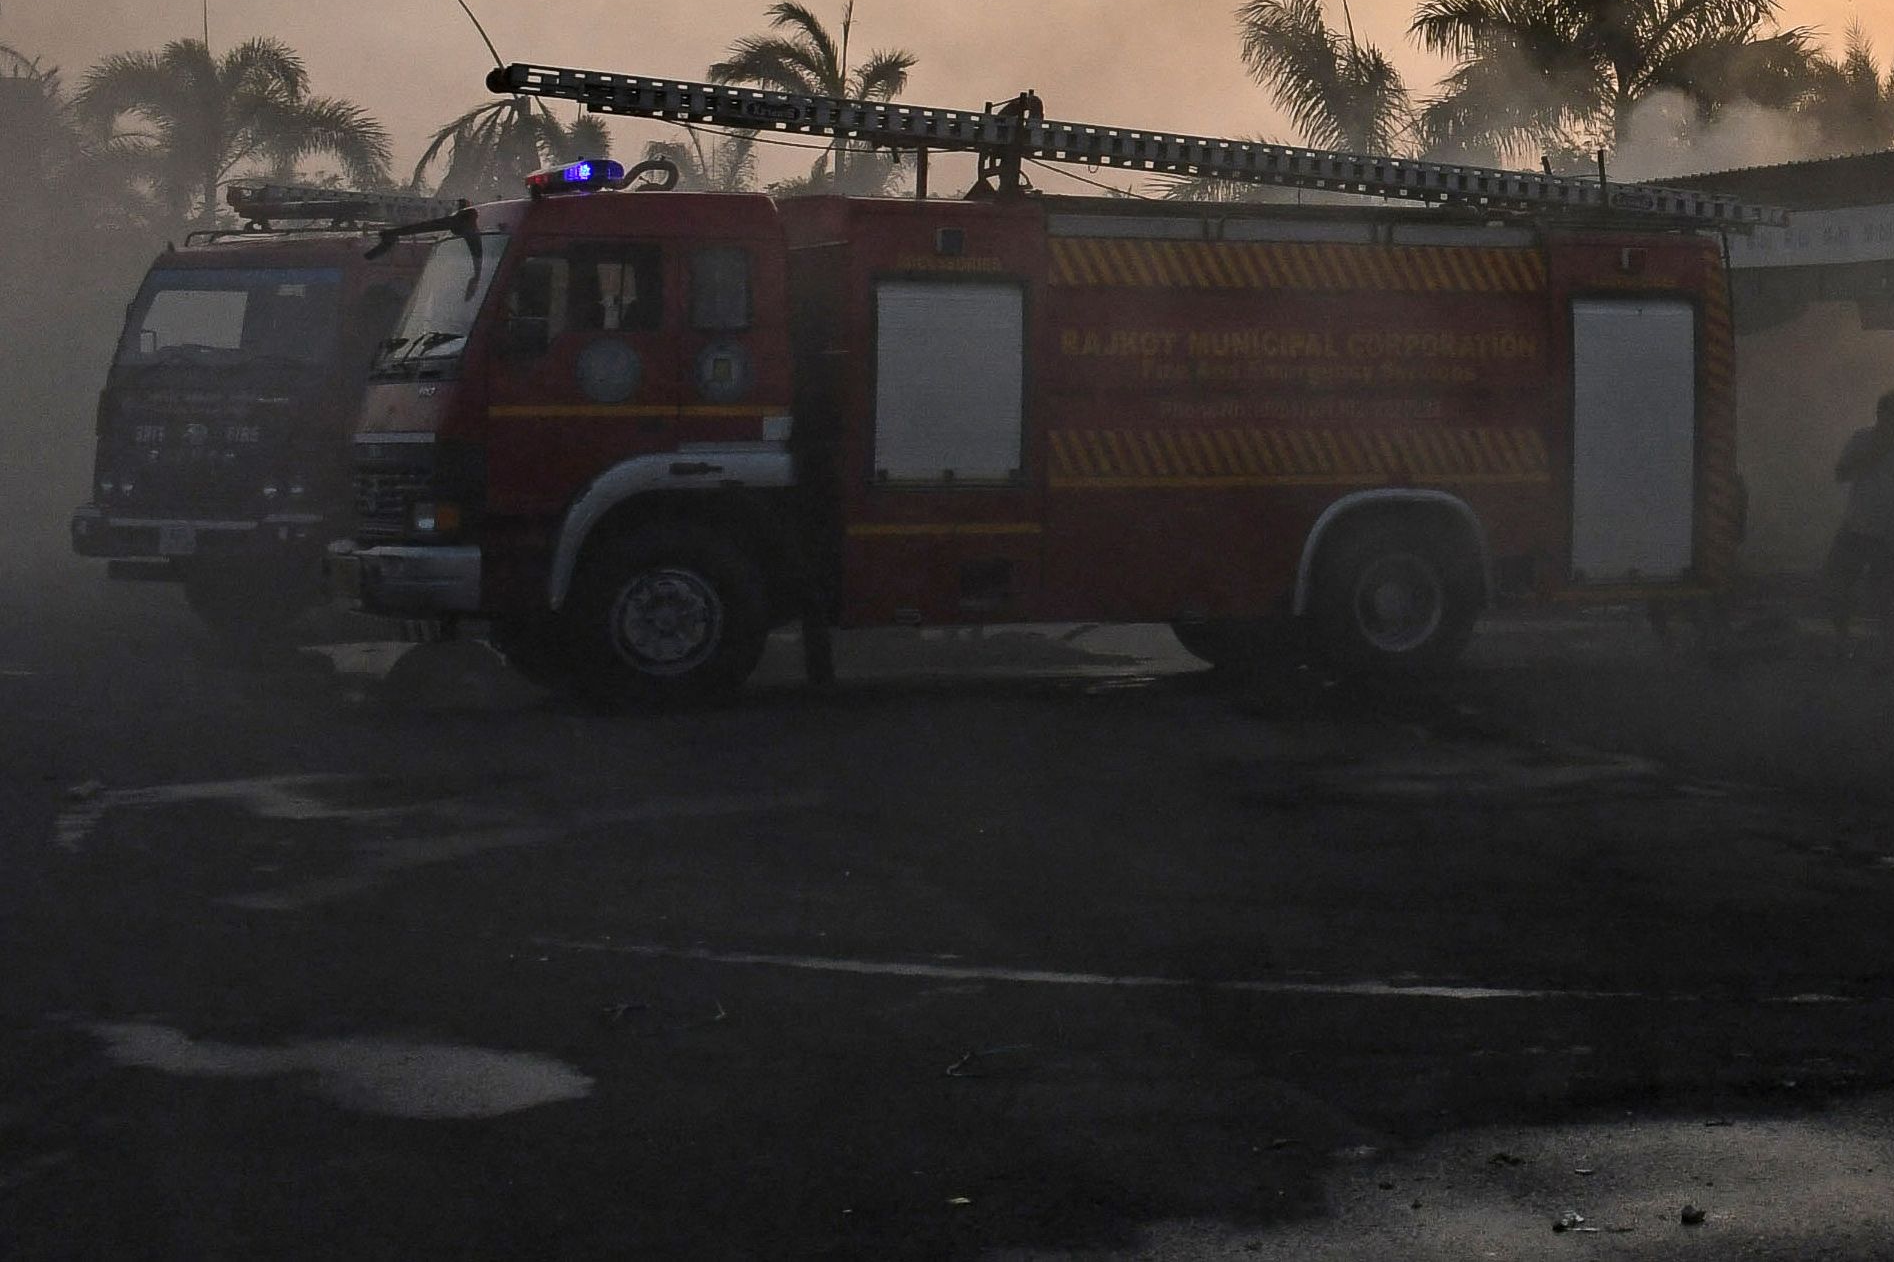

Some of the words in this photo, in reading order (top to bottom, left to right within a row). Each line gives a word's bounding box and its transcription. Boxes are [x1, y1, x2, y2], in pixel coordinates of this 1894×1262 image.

[1060, 328, 1177, 356] RAJKOT
[1187, 329, 1339, 358] MUNICIPAL
[1347, 332, 1537, 360] CORPORATION
